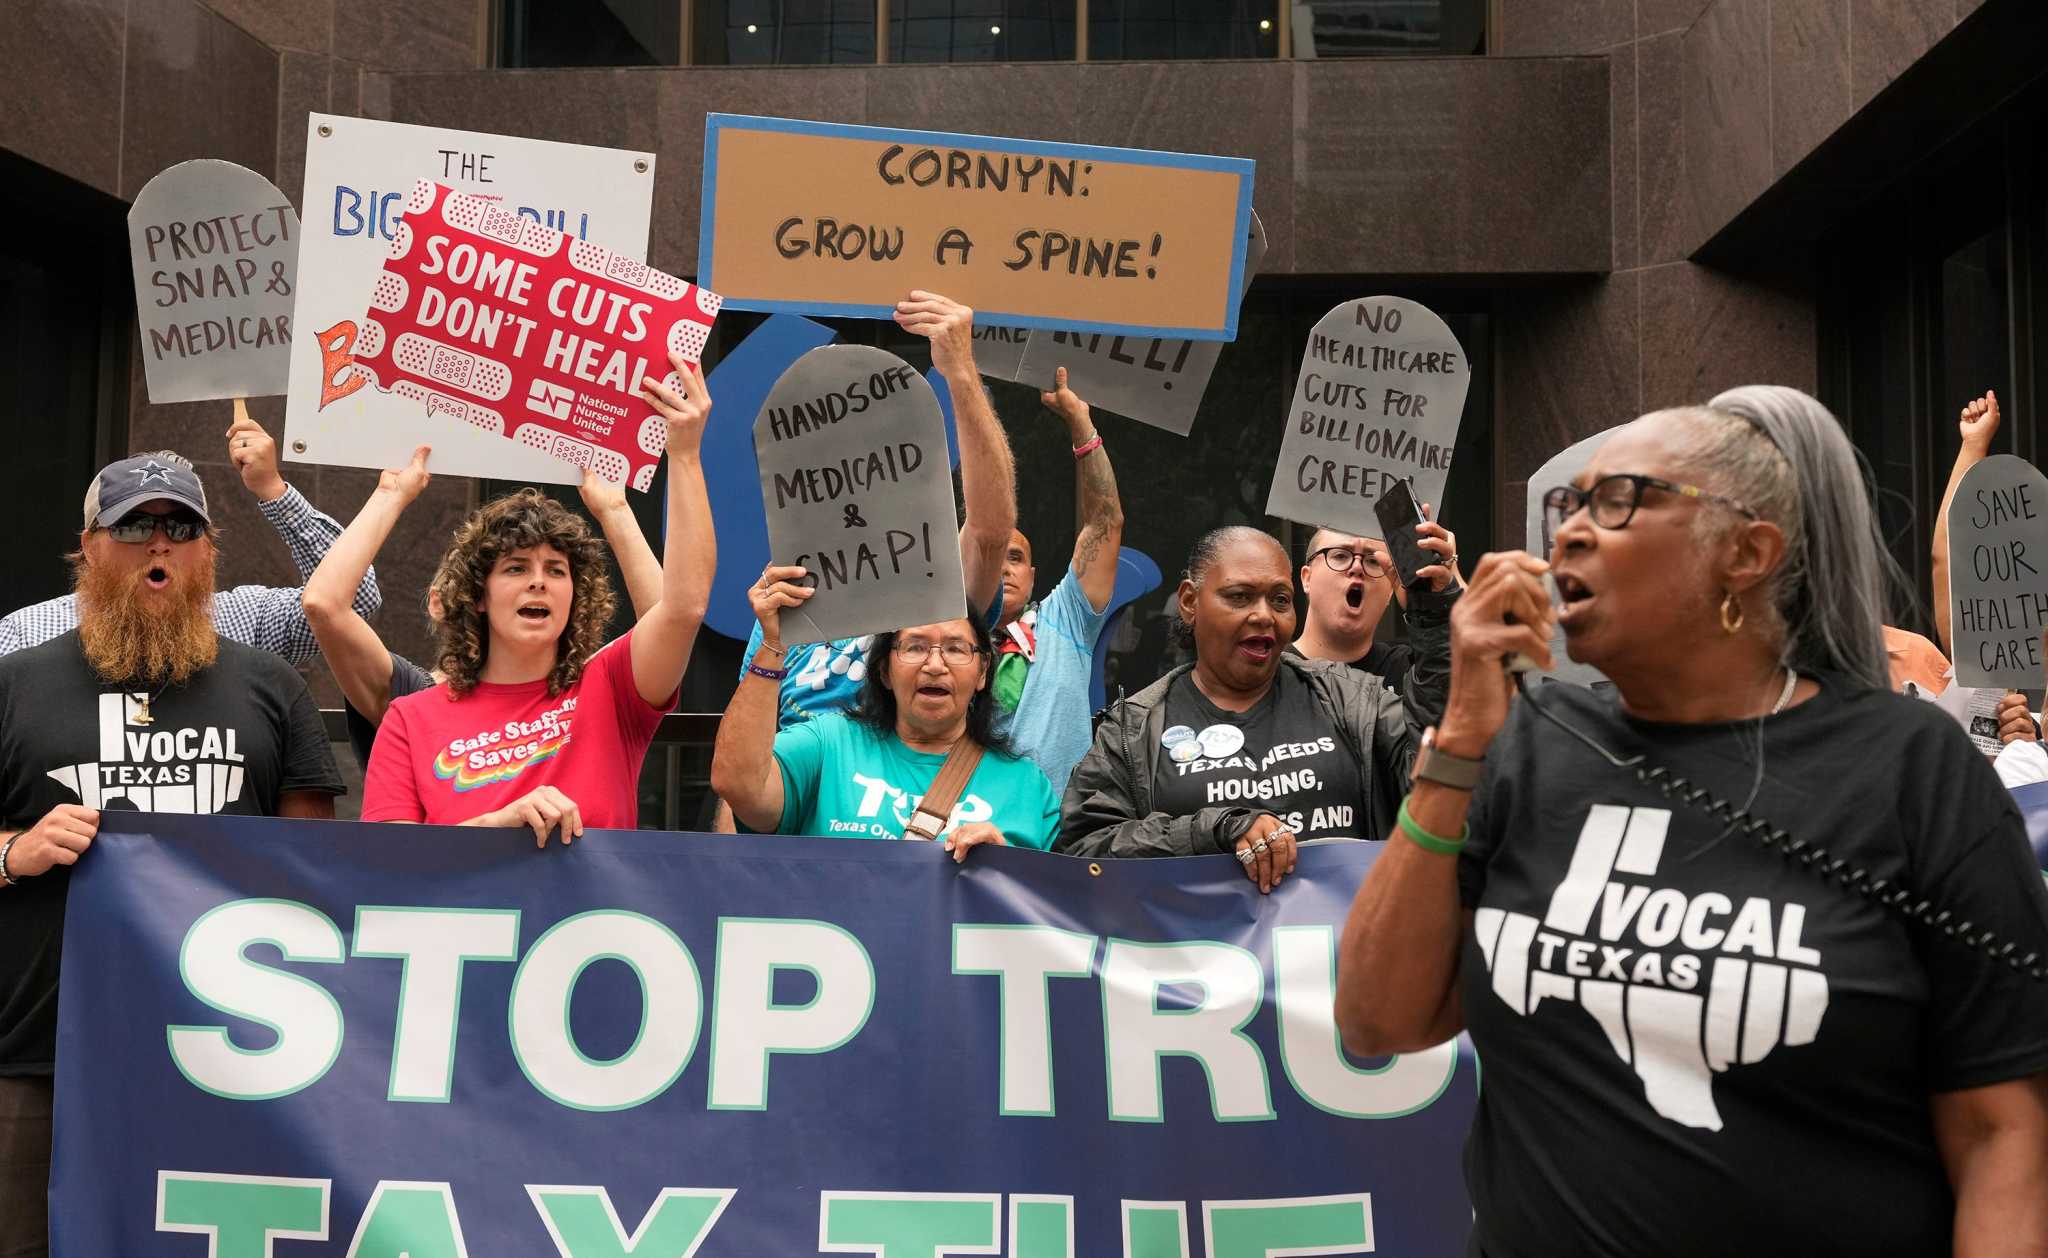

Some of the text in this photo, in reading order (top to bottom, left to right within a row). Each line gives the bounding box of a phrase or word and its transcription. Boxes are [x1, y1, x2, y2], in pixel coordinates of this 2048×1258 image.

[438, 149, 495, 183] THE
[877, 144, 1095, 198] CORNYN:
[144, 205, 294, 262] PROTECT
[333, 185, 403, 241] BIG
[774, 217, 1163, 280] GROW A SPINE!
[152, 258, 291, 307] SNAP &
[419, 235, 653, 342] SOME CUTS
[1355, 303, 1402, 333] NO
[416, 286, 648, 399] DON'T HEAL
[1311, 333, 1456, 374] HEALTHCARE
[575, 404, 616, 425] Nurses
[579, 392, 629, 418] National
[1303, 373, 1428, 417] CUTS FOR
[572, 415, 612, 436] United
[1299, 410, 1454, 470] BILLIONAIRE
[773, 443, 923, 509] MEDICAID
[843, 503, 868, 528] &
[1972, 484, 2036, 529] SAVE
[1974, 541, 2038, 582] OUR
[1980, 636, 2041, 672] CARE
[125, 726, 245, 763] VOCAL
[449, 731, 501, 756] Safe
[469, 741, 538, 769] Saves
[1262, 736, 1336, 772] NEEDS
[100, 764, 191, 785] TEXAS
[1207, 768, 1323, 803] HOUSING,
[829, 819, 867, 832] Texas
[1310, 805, 1354, 832] AND
[1600, 881, 1821, 966] VOCAL
[1537, 933, 1702, 990] TEXAS
[167, 898, 1482, 1124] STOP TRU
